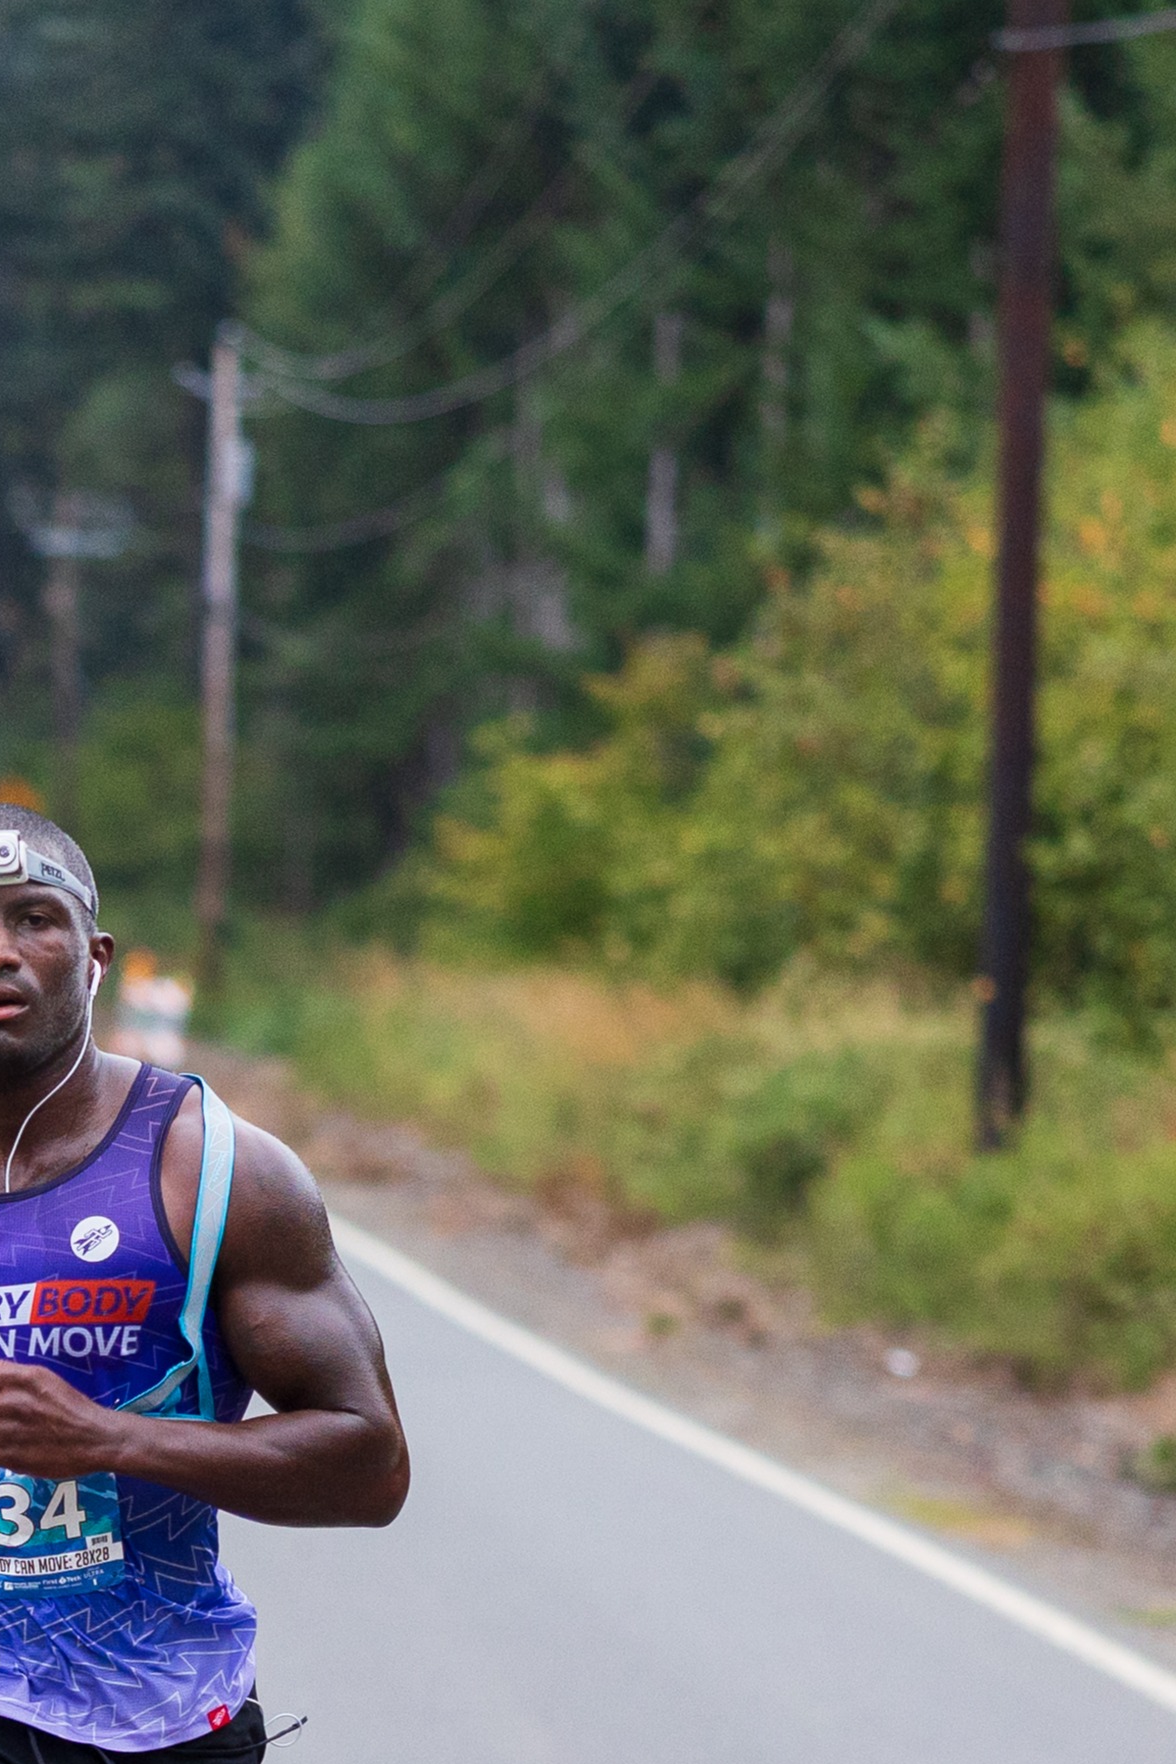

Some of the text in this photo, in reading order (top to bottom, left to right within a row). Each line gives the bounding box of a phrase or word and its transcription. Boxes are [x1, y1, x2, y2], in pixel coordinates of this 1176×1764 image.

[41, 863, 65, 881] PETZL
[37, 1286, 150, 1319] BODY
[28, 1325, 141, 1358] MOVE
[14, 1560, 35, 1574] CAN
[39, 1553, 73, 1572] MOVE:
[75, 1546, 110, 1568] 28X28
